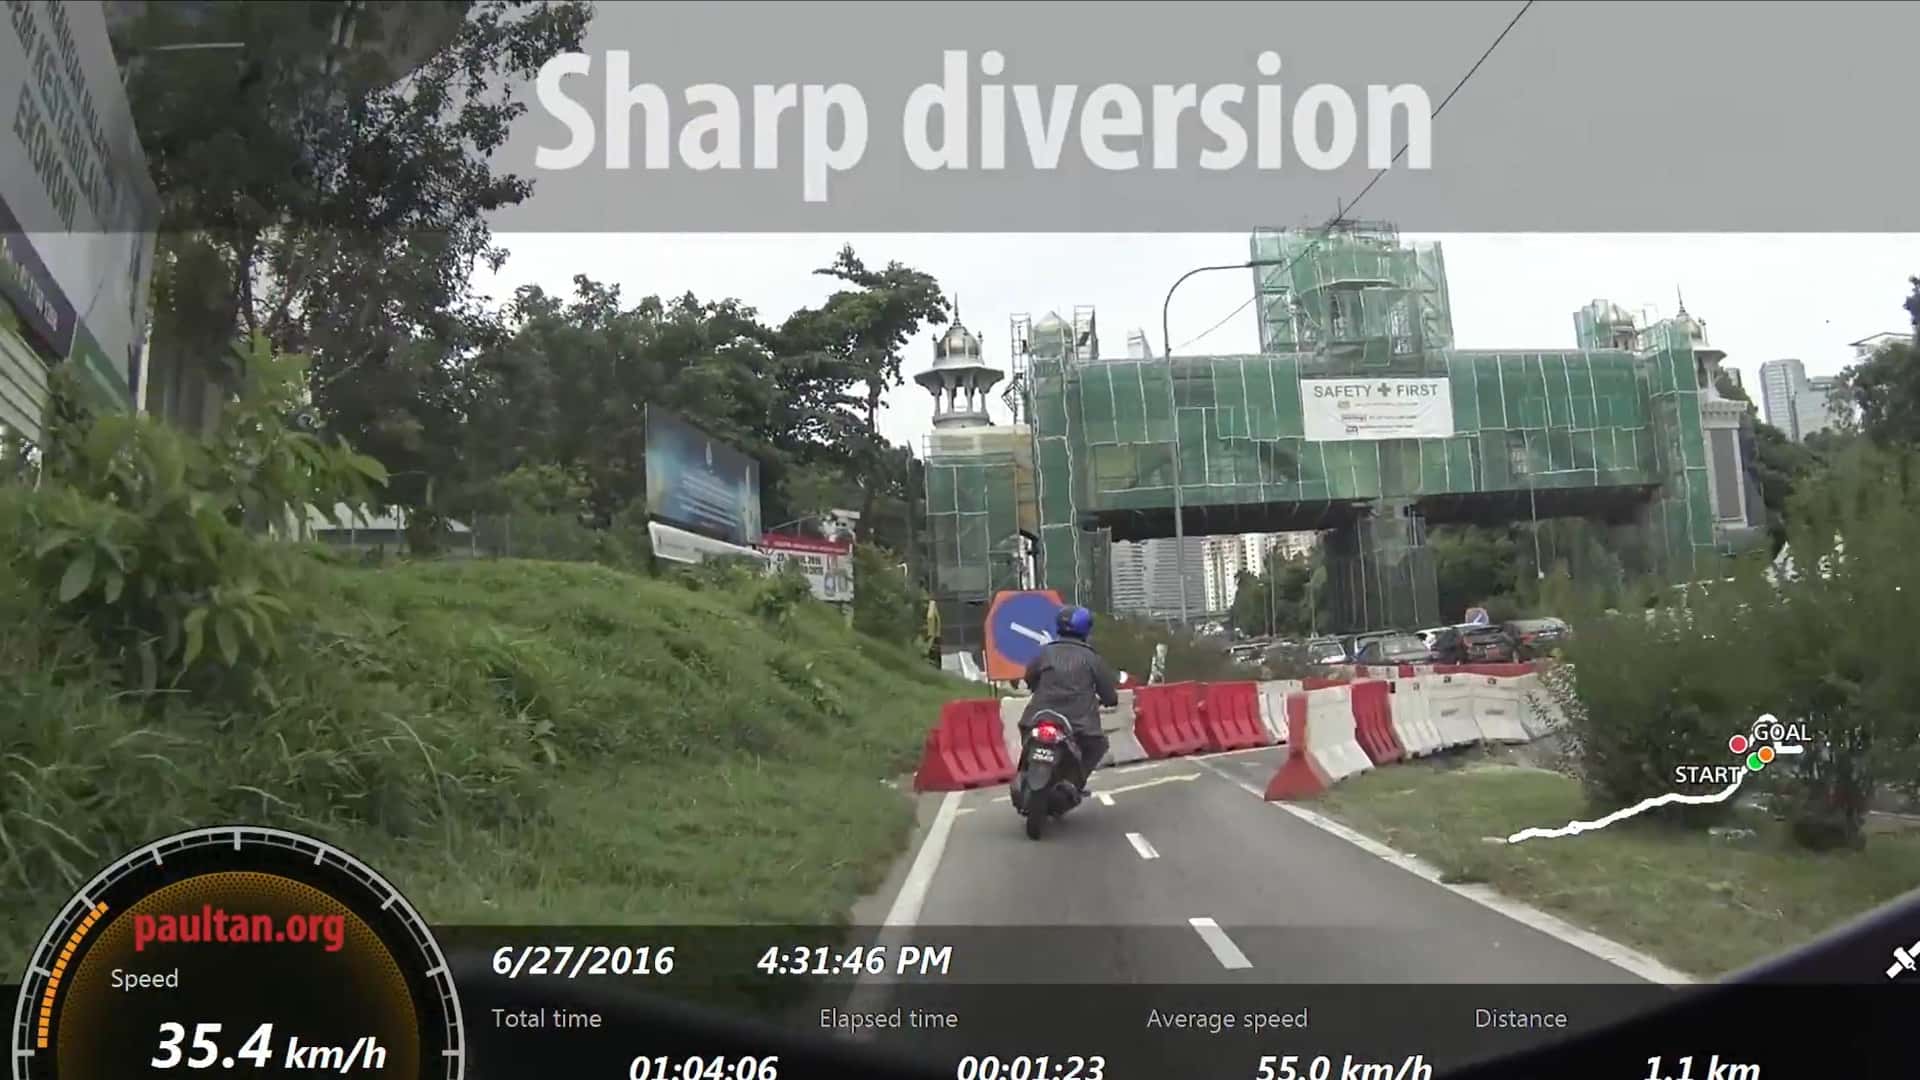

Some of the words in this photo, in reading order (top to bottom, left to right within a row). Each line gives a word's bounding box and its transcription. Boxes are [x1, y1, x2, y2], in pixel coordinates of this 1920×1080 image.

[14, 80, 78, 233] EKONOMI
[1313, 384, 1372, 398] SAFETY
[1396, 383, 1439, 397] FIRST
